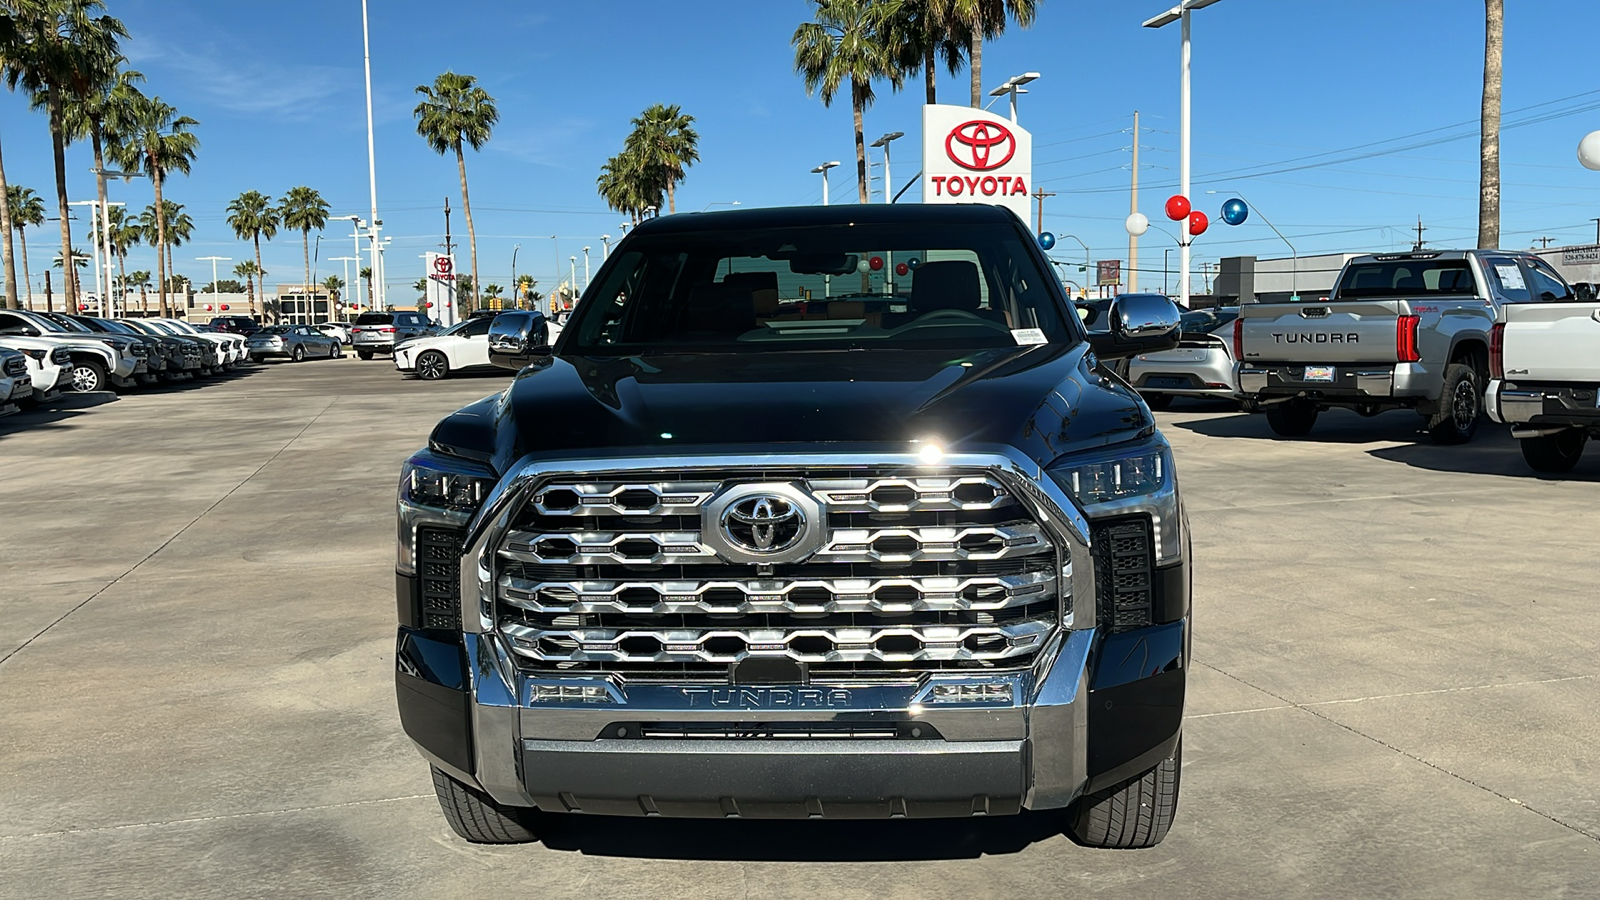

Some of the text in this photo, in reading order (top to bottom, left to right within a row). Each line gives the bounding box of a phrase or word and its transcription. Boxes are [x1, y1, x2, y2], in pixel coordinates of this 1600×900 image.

[931, 176, 1028, 197] TOYOTA
[1271, 333, 1360, 344] TUNDRA
[682, 689, 852, 707] TUNDRA
